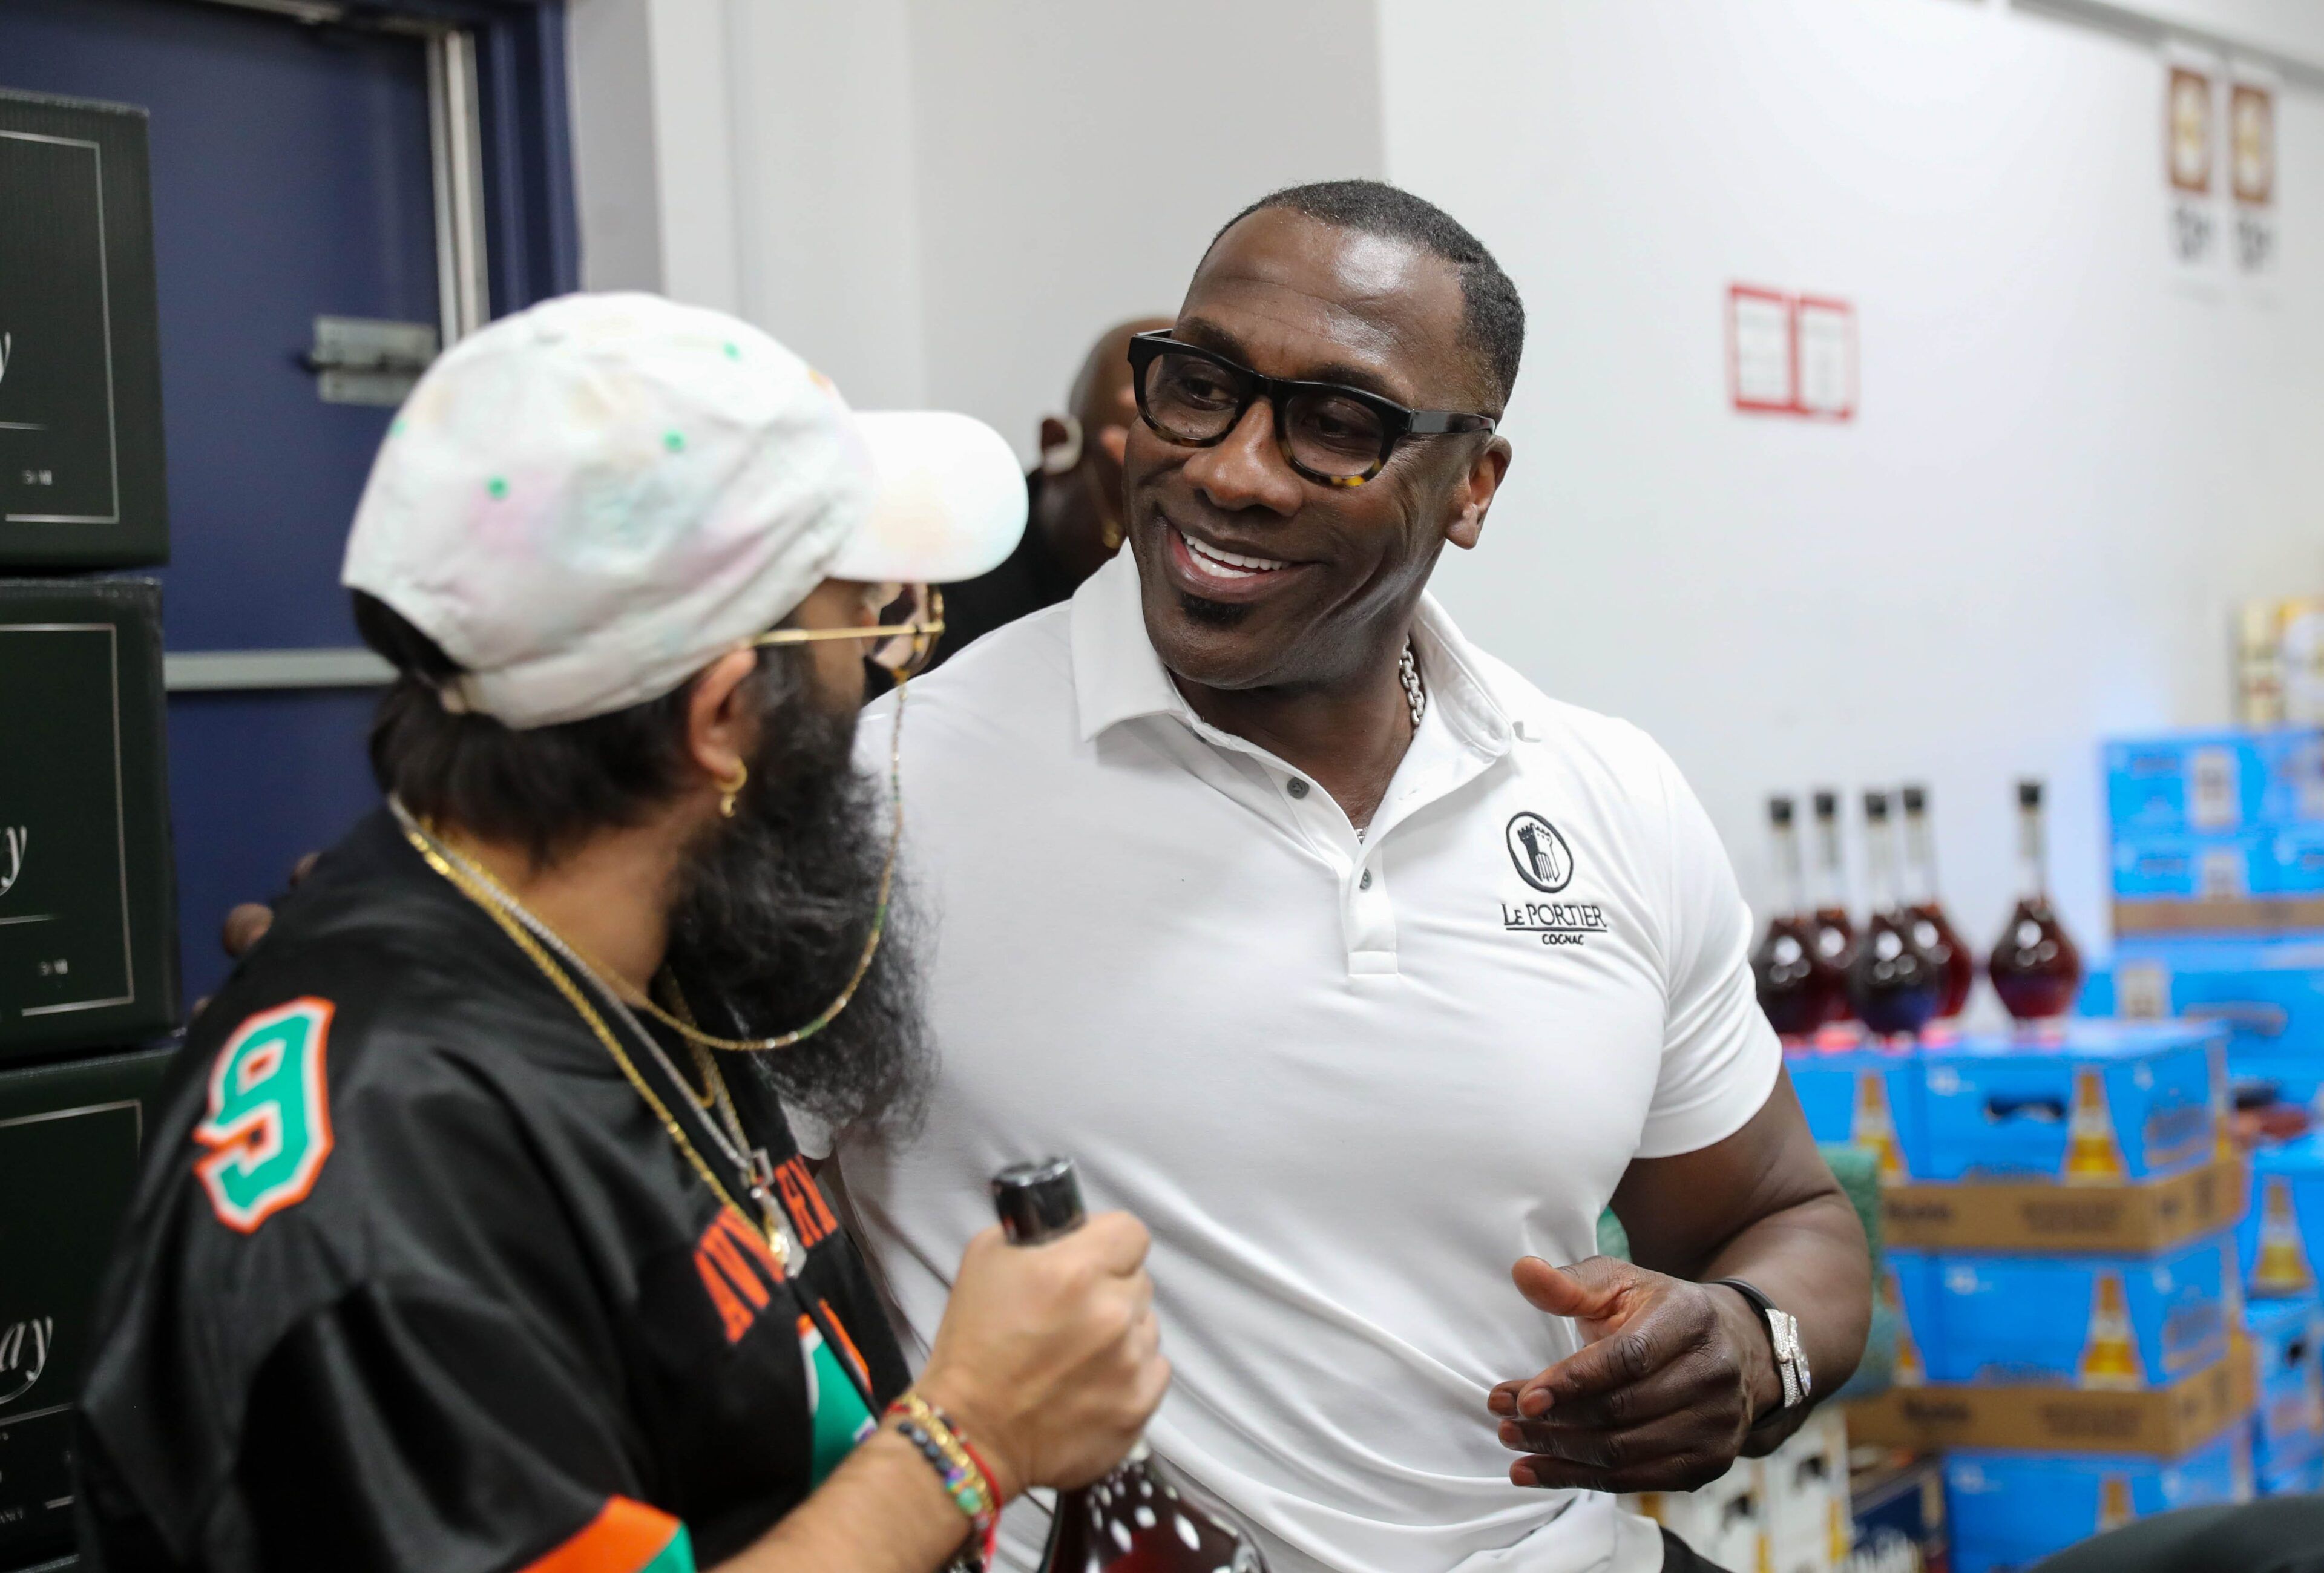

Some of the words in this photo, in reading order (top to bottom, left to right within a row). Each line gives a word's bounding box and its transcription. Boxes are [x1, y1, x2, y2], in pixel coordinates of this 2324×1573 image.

[1525, 904, 1607, 928] PORTIER
[1542, 934, 1584, 945] COGNAC
[191, 994, 337, 1235] 9
[693, 1152, 838, 1344] AVIRY
